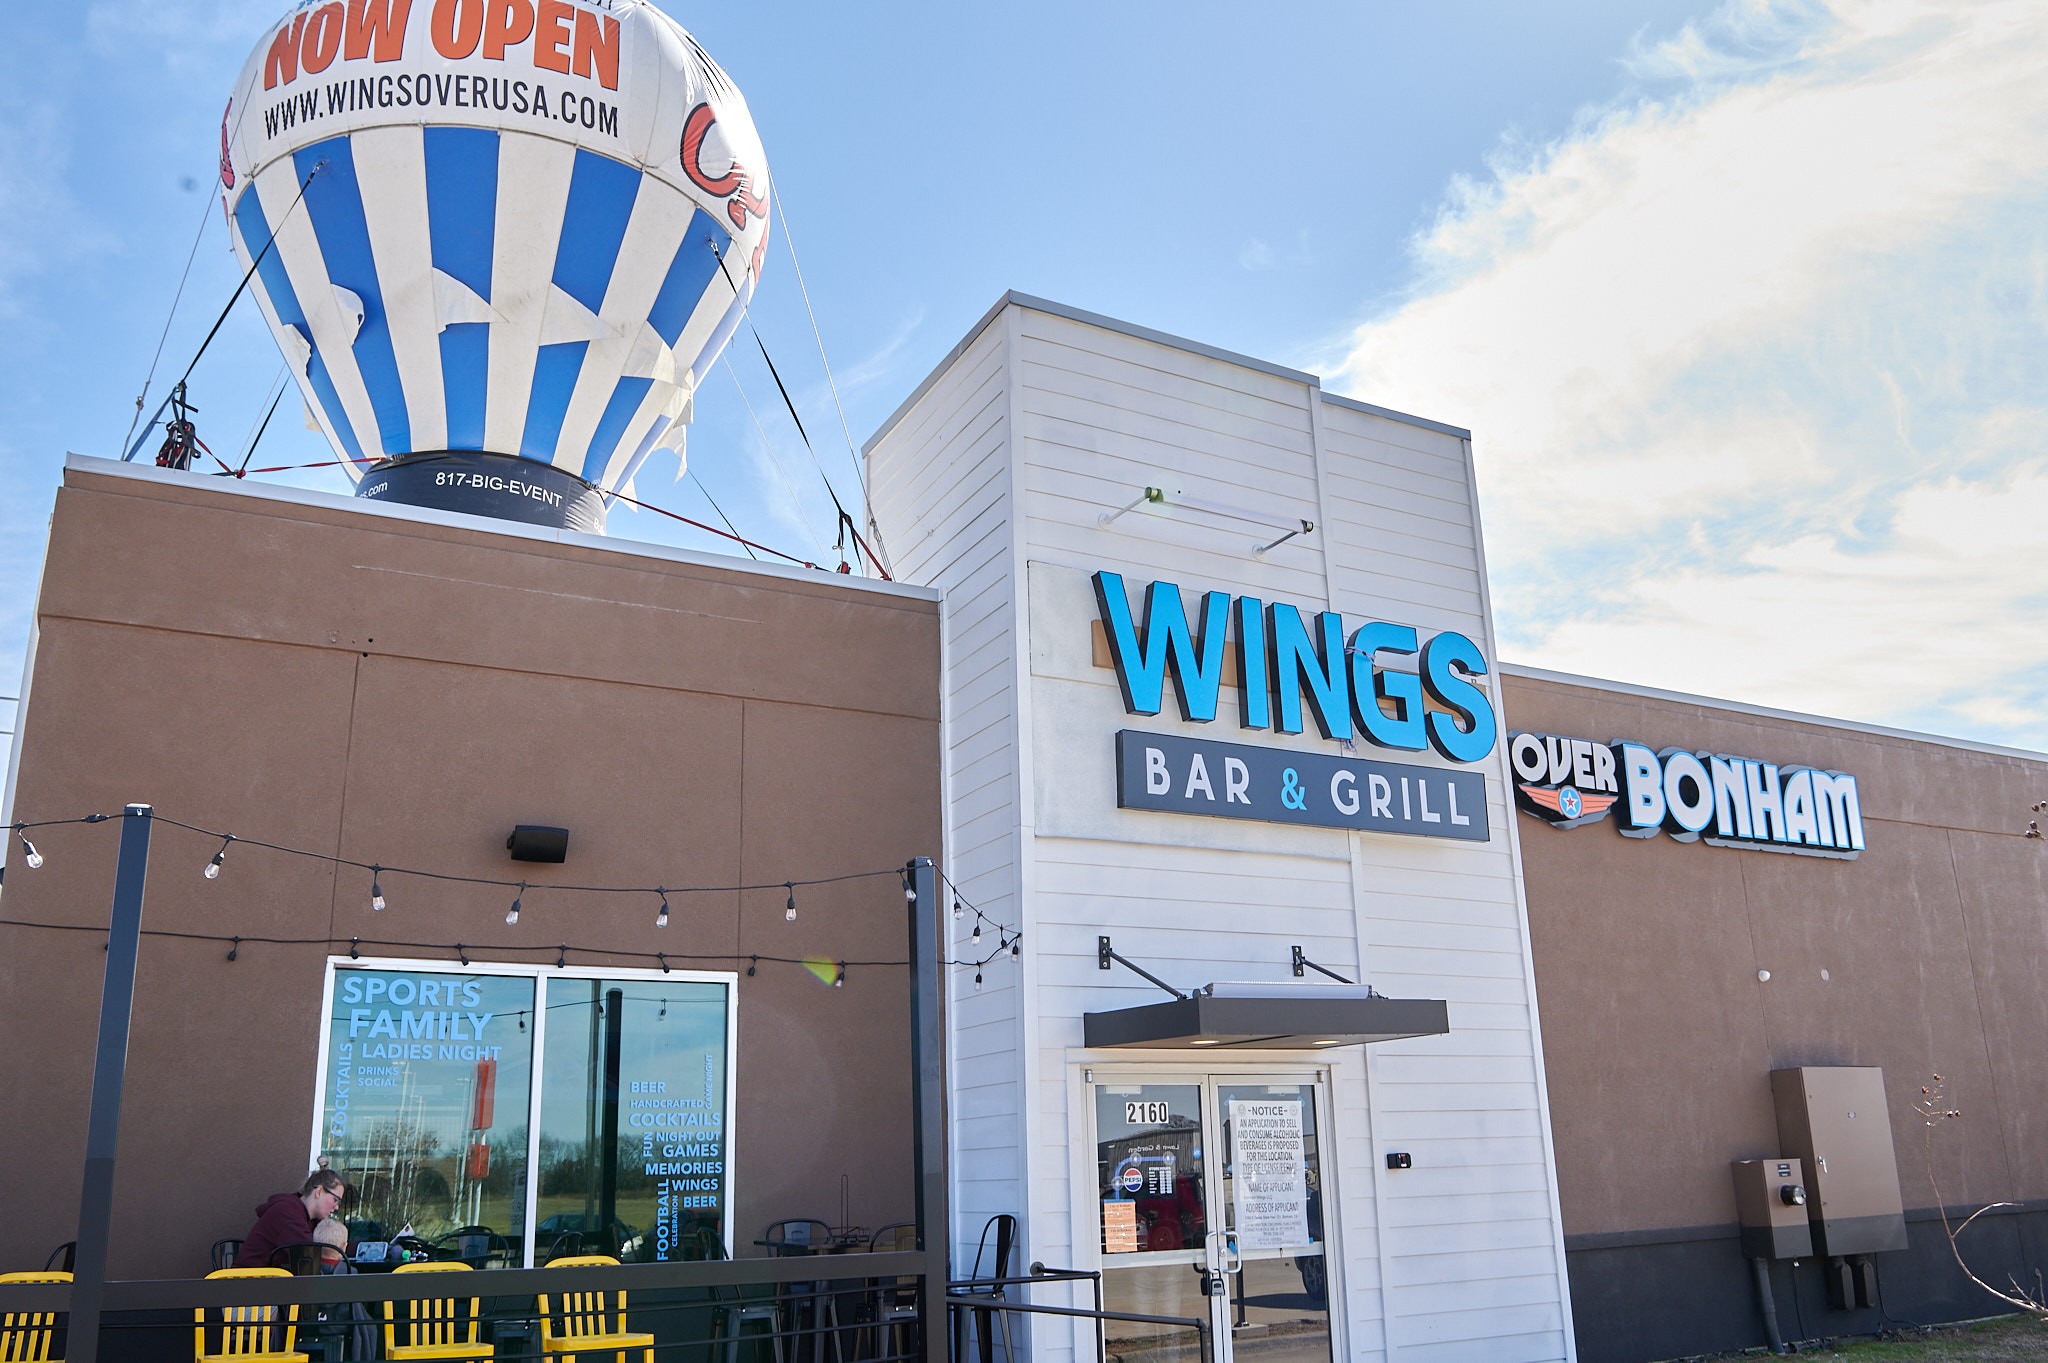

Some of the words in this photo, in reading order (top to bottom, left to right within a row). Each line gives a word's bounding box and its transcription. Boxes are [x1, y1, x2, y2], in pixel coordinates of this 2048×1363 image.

[264, 0, 412, 92] NOW
[430, 0, 621, 92] OPEN
[264, 73, 619, 141] WWW.WINGSOVERUSA.COM
[435, 471, 563, 508] 817-BIG-EVENT
[1091, 570, 1497, 763] WINGS
[1145, 747, 1252, 805] BAR
[1280, 767, 1308, 811] &
[1330, 769, 1470, 826] GRILL
[1511, 733, 1618, 793] OVER
[1622, 742, 1866, 850] BONHAM
[342, 976, 482, 1008] SPORTS
[349, 1008, 494, 1041] FAMILY
[361, 1043, 433, 1061] LADIES
[438, 1045, 502, 1062] NIGHT
[358, 1066, 400, 1077] DRINKS
[332, 1042, 353, 1137] COCKTAILS
[357, 1077, 397, 1087] SOCIAL
[630, 1081, 666, 1093] BEER
[630, 1099, 704, 1109] HANDCRAFTED
[705, 1082, 713, 1110] GAME
[629, 1112, 721, 1127] COCKTAILS
[1127, 1102, 1167, 1123] 2160
[1240, 1119, 1247, 1128] AN
[1248, 1119, 1278, 1128] APPLICATION
[1279, 1119, 1285, 1128] TO
[1286, 1118, 1297, 1128] SELL
[643, 1131, 653, 1157] FUN
[655, 1131, 693, 1142] NIGHT
[695, 1130, 720, 1141] OUT
[1238, 1130, 1248, 1138] AND
[1249, 1130, 1272, 1139] CONSUME
[1273, 1130, 1300, 1139] ALCOHOLIC
[662, 1143, 719, 1158] GAMES
[1240, 1140, 1267, 1150] BEVERAGES
[1273, 1140, 1299, 1150] PROPOSED
[1246, 1152, 1257, 1161] FOR
[1257, 1152, 1267, 1161] THIS
[645, 1161, 723, 1176] MEMORIES
[671, 1179, 719, 1191] WINGS
[683, 1195, 717, 1208] BEER
[656, 1178, 669, 1261] FOOTBALL
[671, 1195, 679, 1247] CELEBRATION
